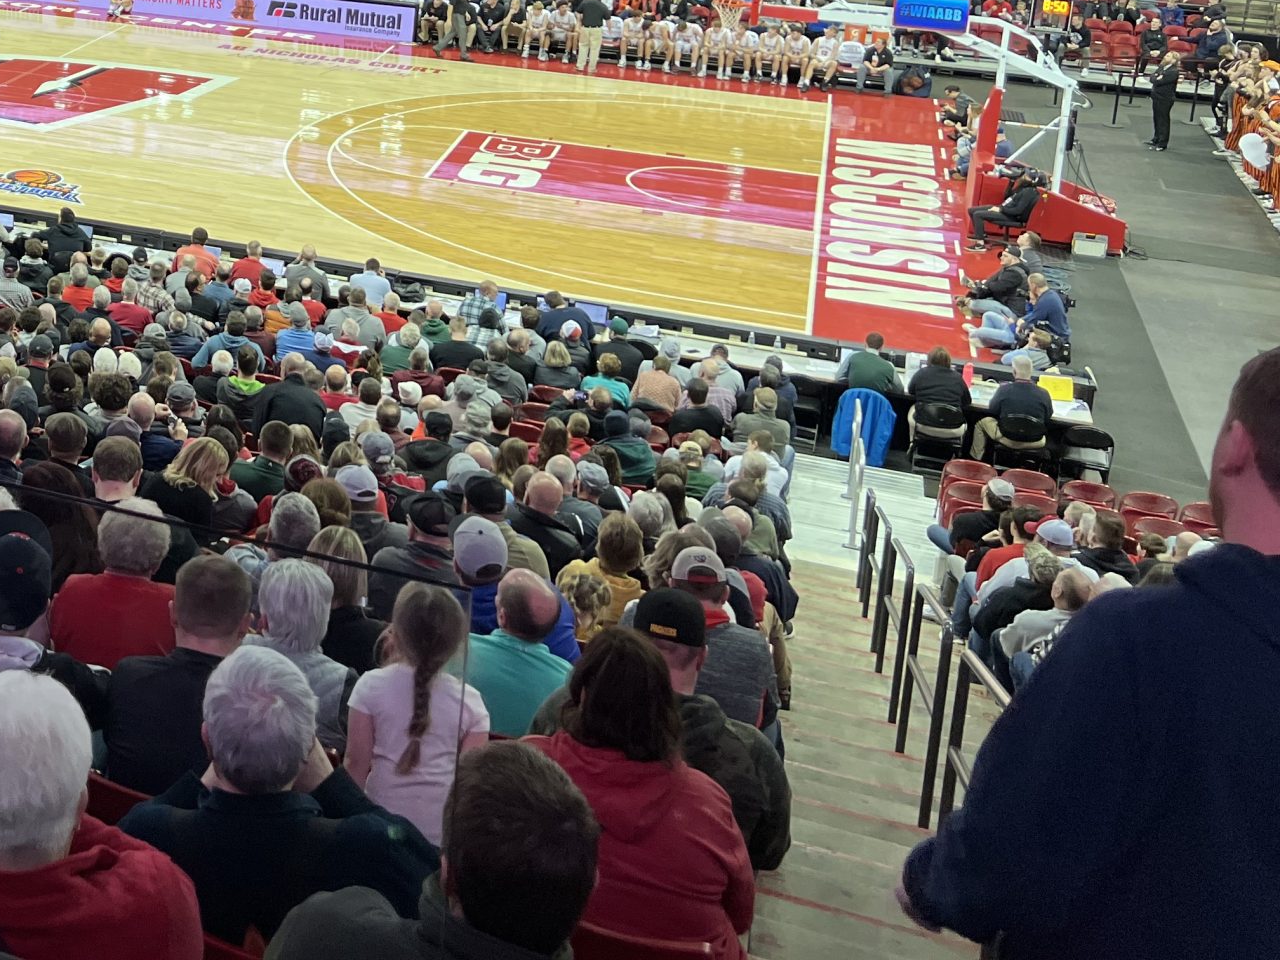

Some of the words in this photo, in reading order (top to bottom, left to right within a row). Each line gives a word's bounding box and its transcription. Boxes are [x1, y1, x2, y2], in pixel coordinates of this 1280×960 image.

[300, 3, 341, 23] Rural
[346, 7, 402, 30] Mutual
[900, 3, 963, 22] #WIAABB
[1043, 0, 1069, 13] 8:50
[119, 14, 317, 40] CENTER
[373, 27, 401, 37] Company
[254, 48, 365, 65] NICHOLAS
[368, 61, 449, 75] COURT
[825, 137, 955, 318] WISCONSIN
